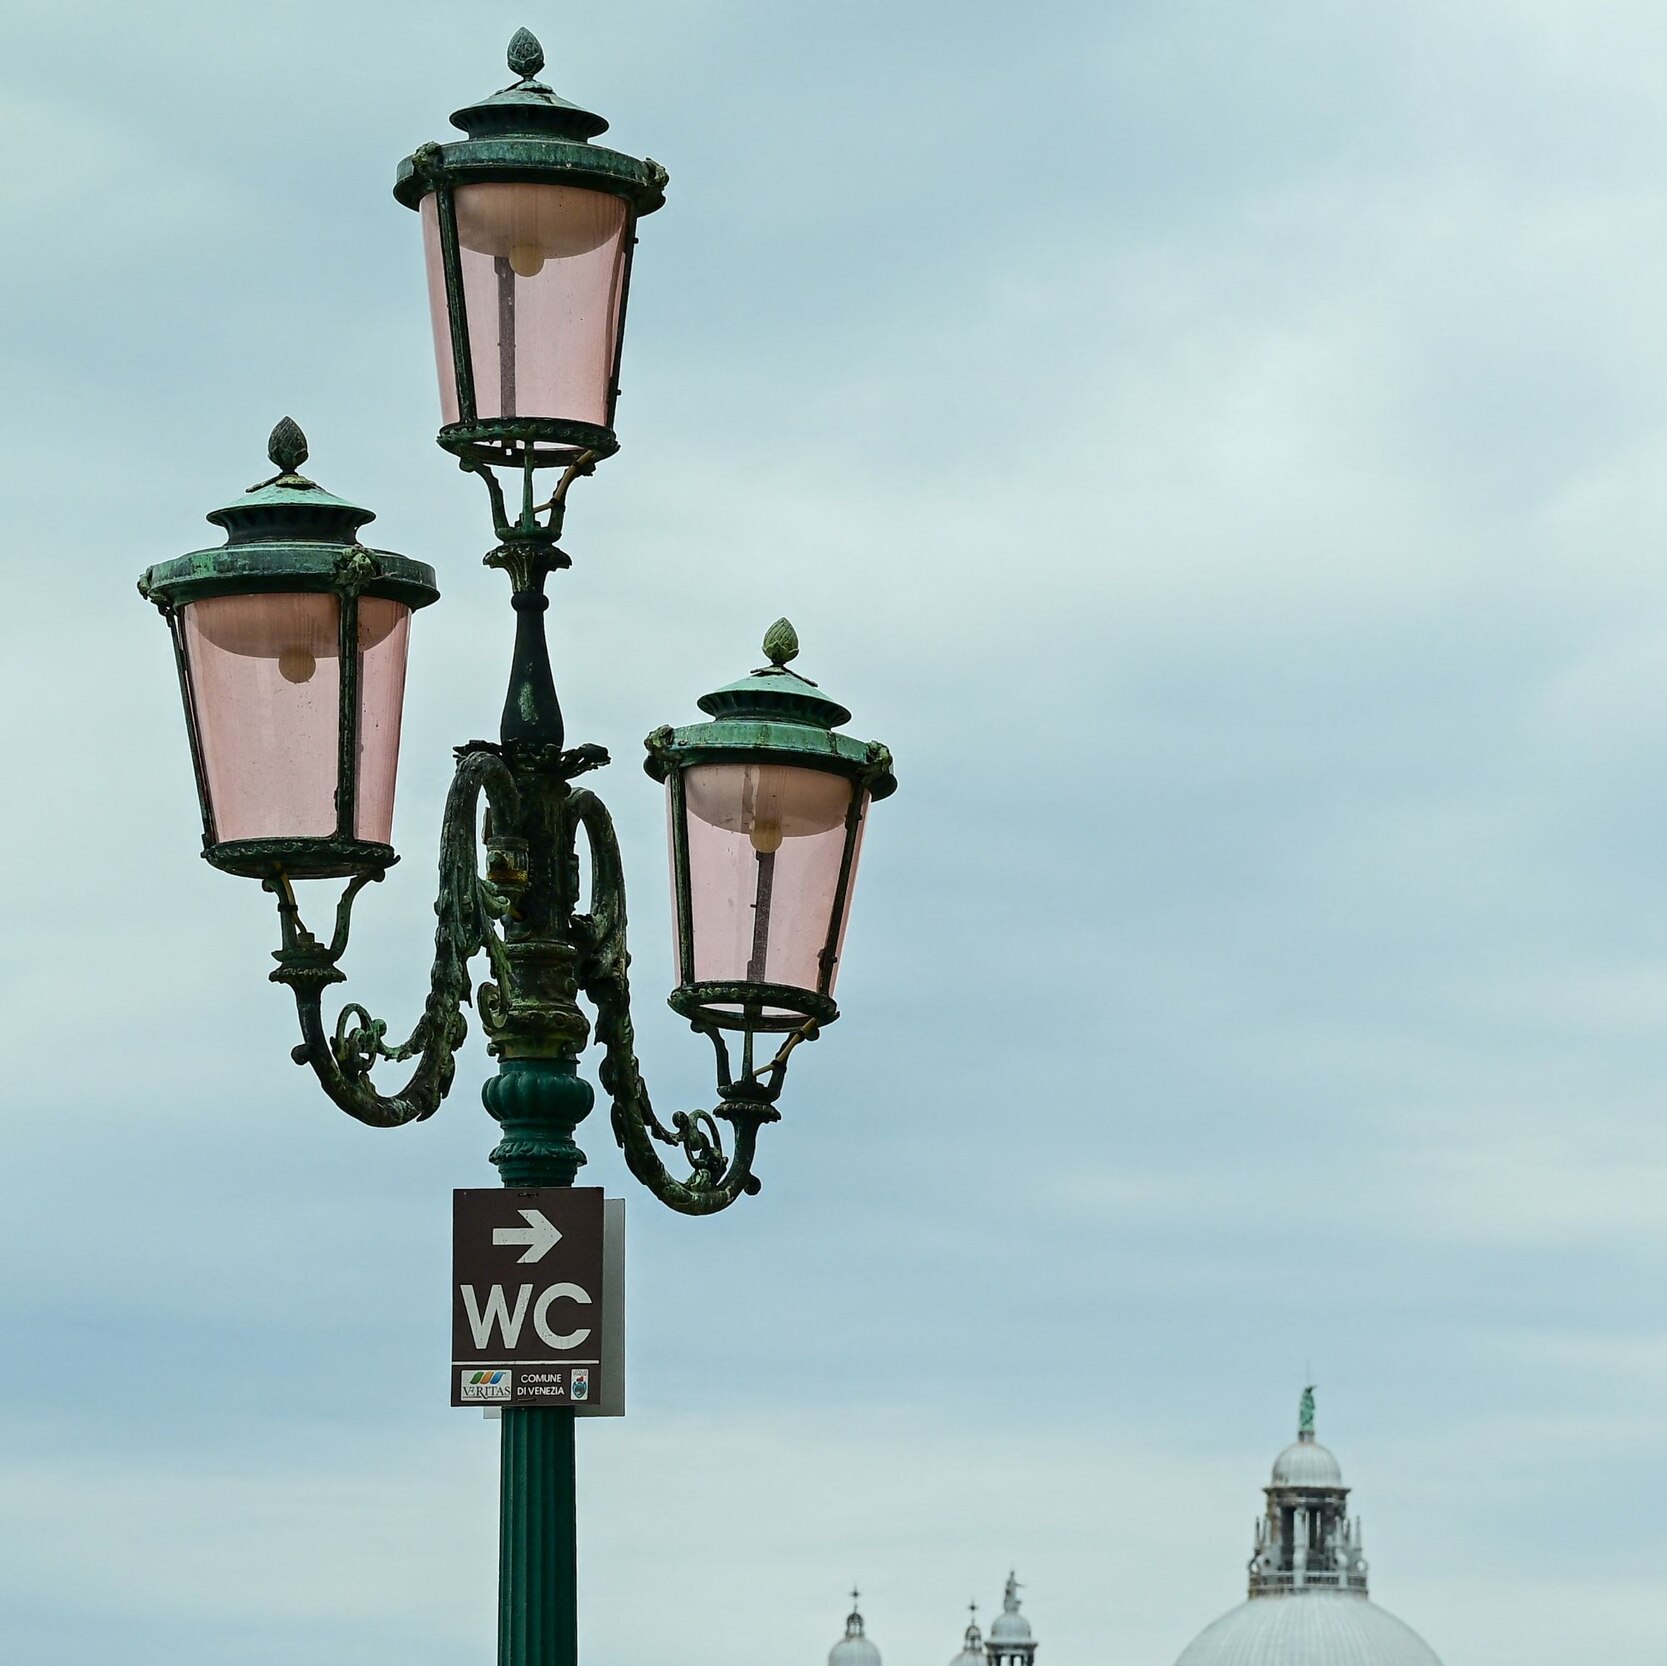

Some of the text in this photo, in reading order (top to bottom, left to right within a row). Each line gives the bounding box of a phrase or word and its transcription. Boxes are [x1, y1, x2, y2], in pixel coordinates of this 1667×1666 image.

[460, 1282, 592, 1350] WC
[520, 1374, 562, 1383] COMUNE
[463, 1386, 511, 1399] VERITAS
[517, 1387, 565, 1396] DI VENEZIA
